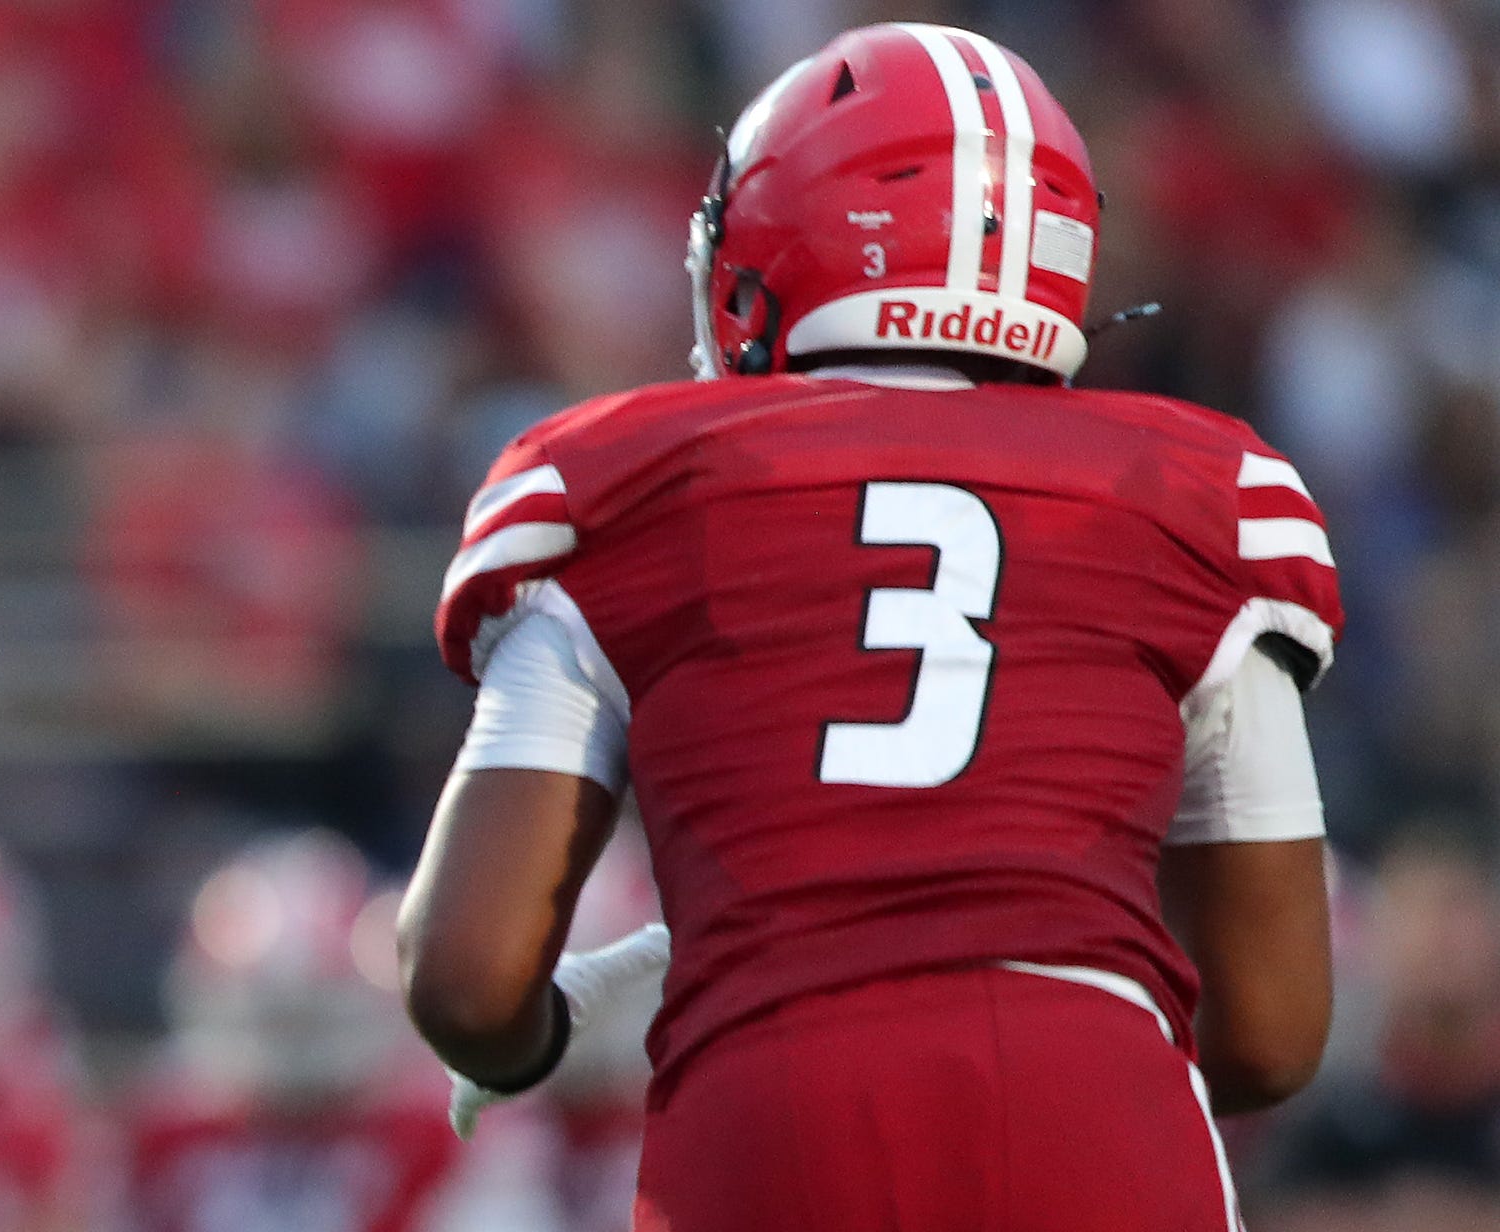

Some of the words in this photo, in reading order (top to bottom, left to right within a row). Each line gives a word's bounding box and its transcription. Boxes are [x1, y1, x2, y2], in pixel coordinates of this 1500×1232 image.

[861, 242, 887, 279] 3
[876, 300, 1061, 362] Riddell
[817, 480, 1004, 790] 3
